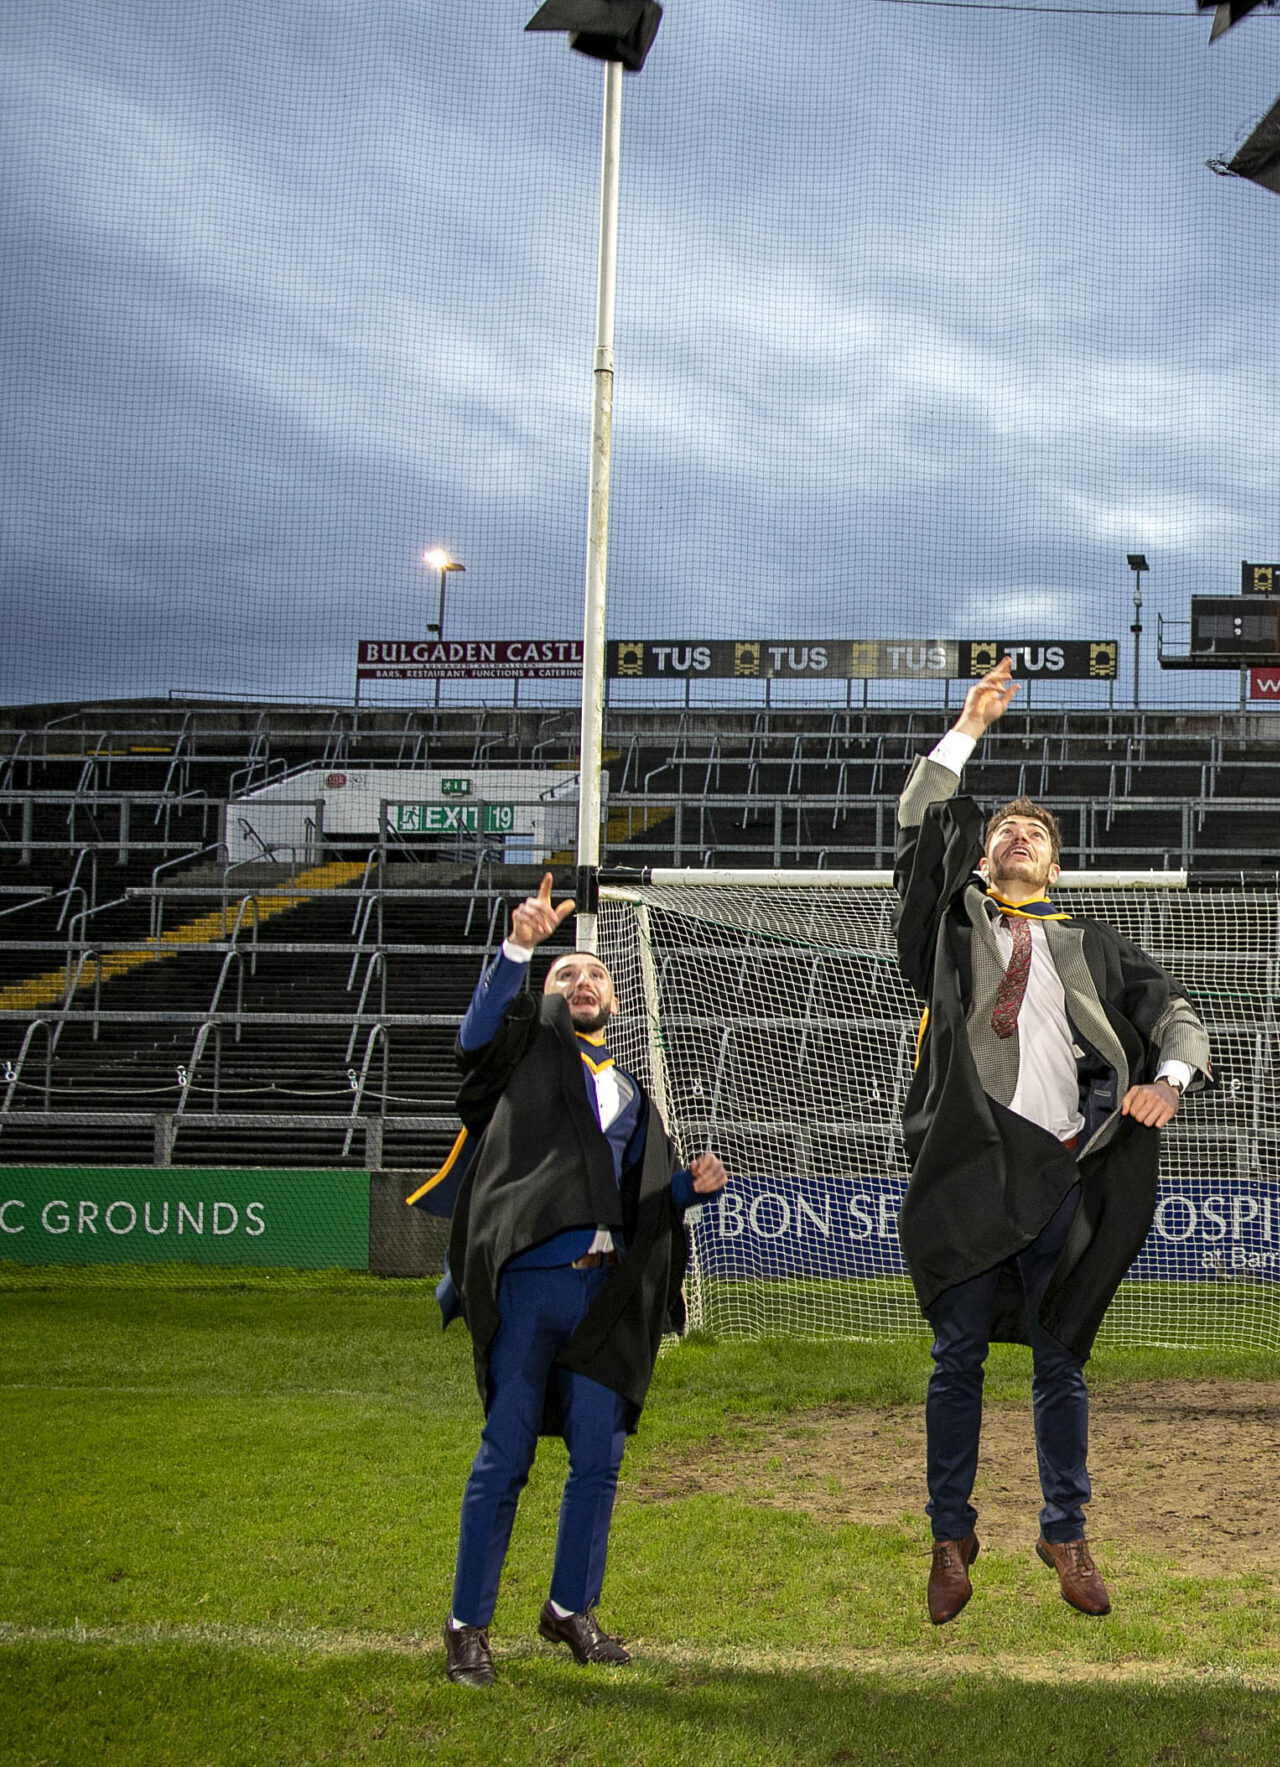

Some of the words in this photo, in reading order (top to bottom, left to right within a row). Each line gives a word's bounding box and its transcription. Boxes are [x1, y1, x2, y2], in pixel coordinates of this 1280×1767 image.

[366, 644, 496, 661] BULGADEN
[506, 643, 582, 661] CASTL
[652, 647, 712, 671] TUS
[768, 647, 828, 671] TUS
[886, 647, 946, 671] TUS
[1004, 646, 1065, 671] TUS
[472, 669, 525, 678] FUNCTIONS
[528, 669, 535, 678] &
[426, 806, 478, 829] EXIT
[493, 806, 512, 829] 19
[41, 1200, 266, 1236] GROUNDS
[718, 1193, 831, 1238] BON
[1201, 1249, 1223, 1268] at
